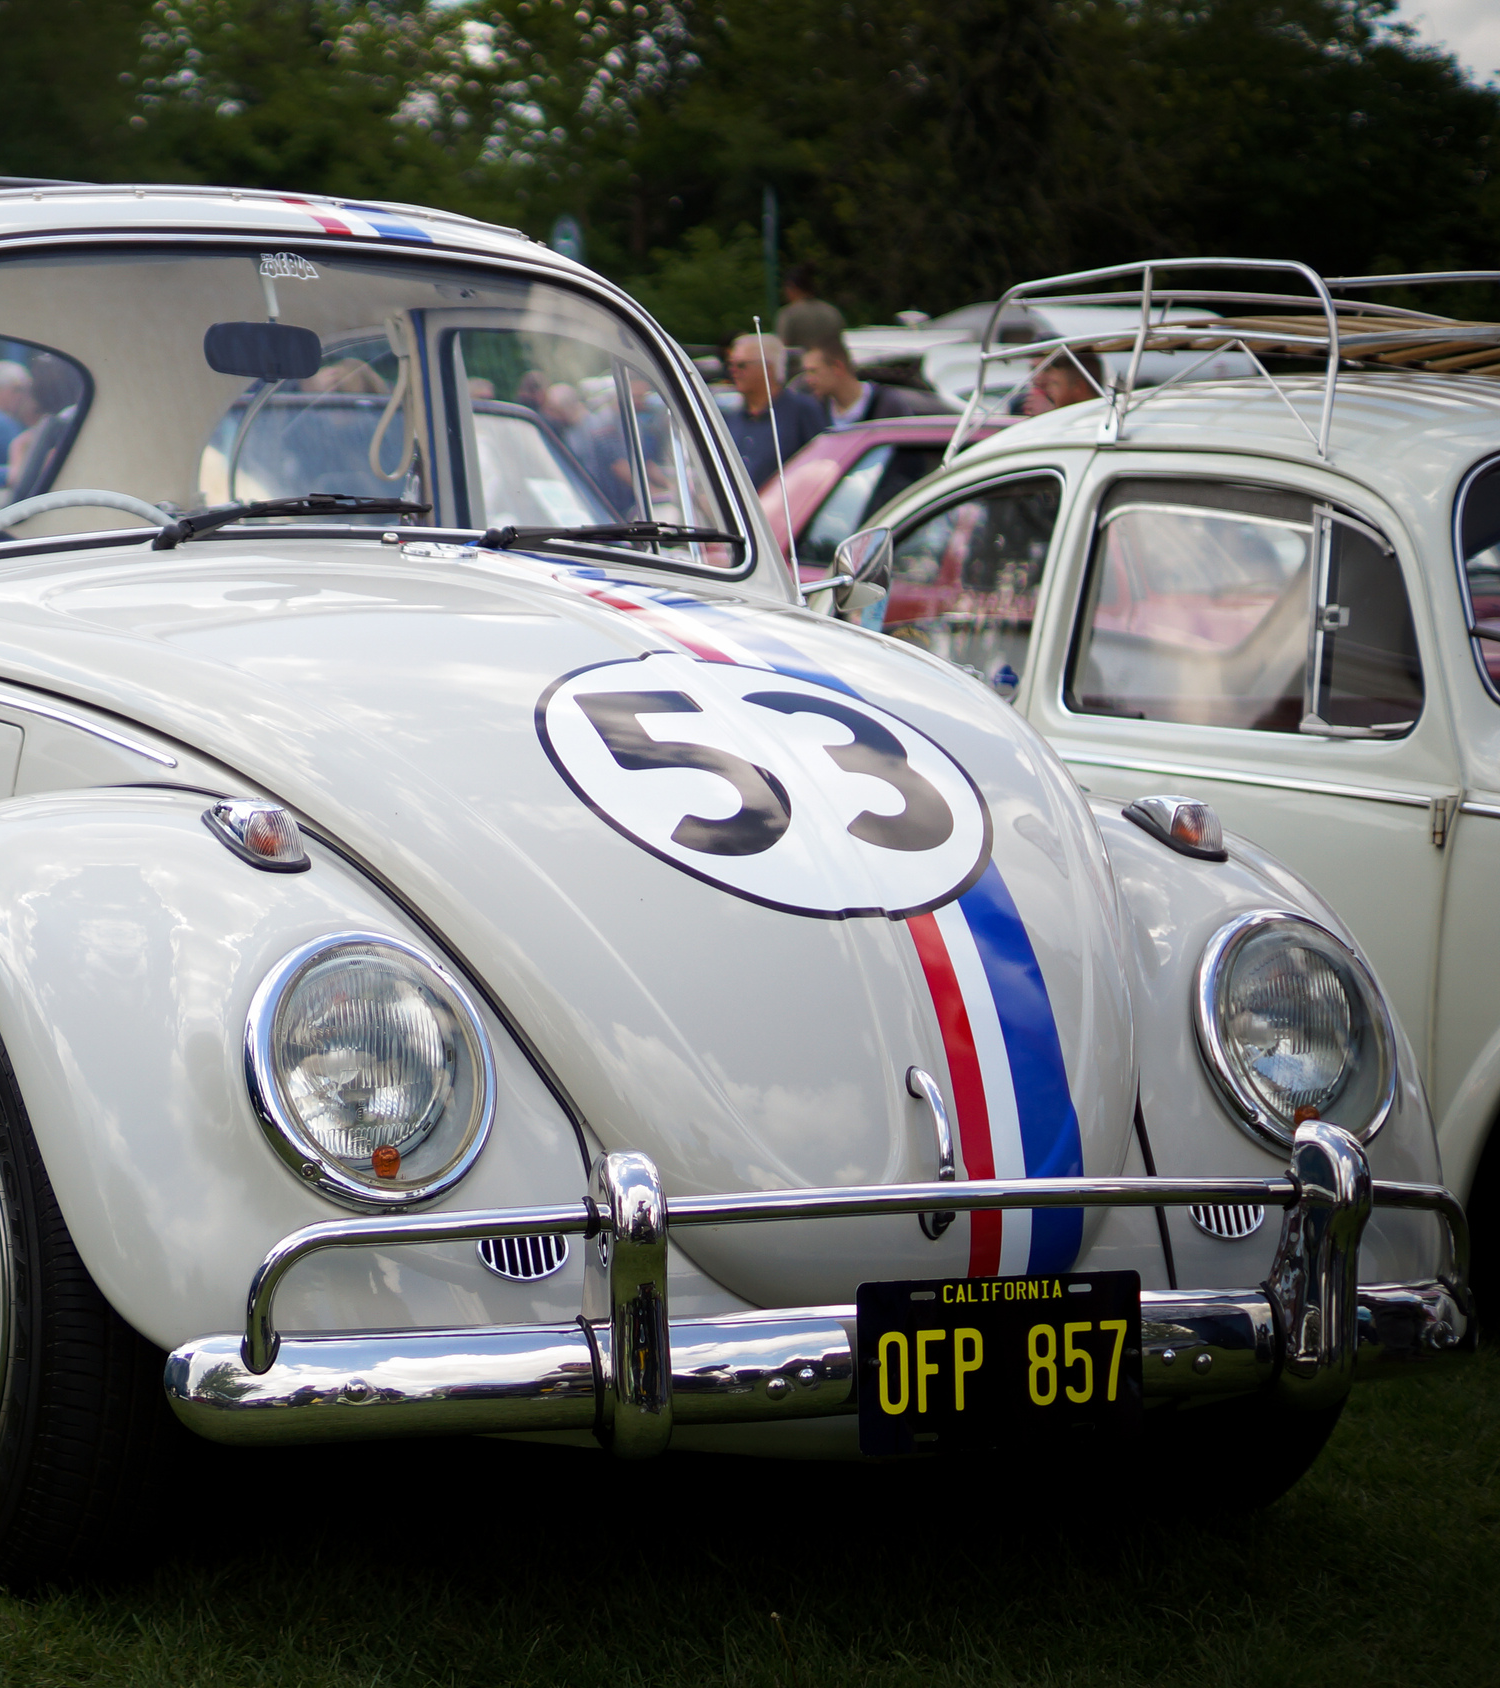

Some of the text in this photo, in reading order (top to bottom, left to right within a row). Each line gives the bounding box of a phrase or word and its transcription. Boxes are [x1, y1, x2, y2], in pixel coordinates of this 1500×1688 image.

[573, 690, 955, 857] 53
[942, 1279, 1063, 1304] CALIFORNIA
[878, 1319, 1128, 1415] OFP 857
